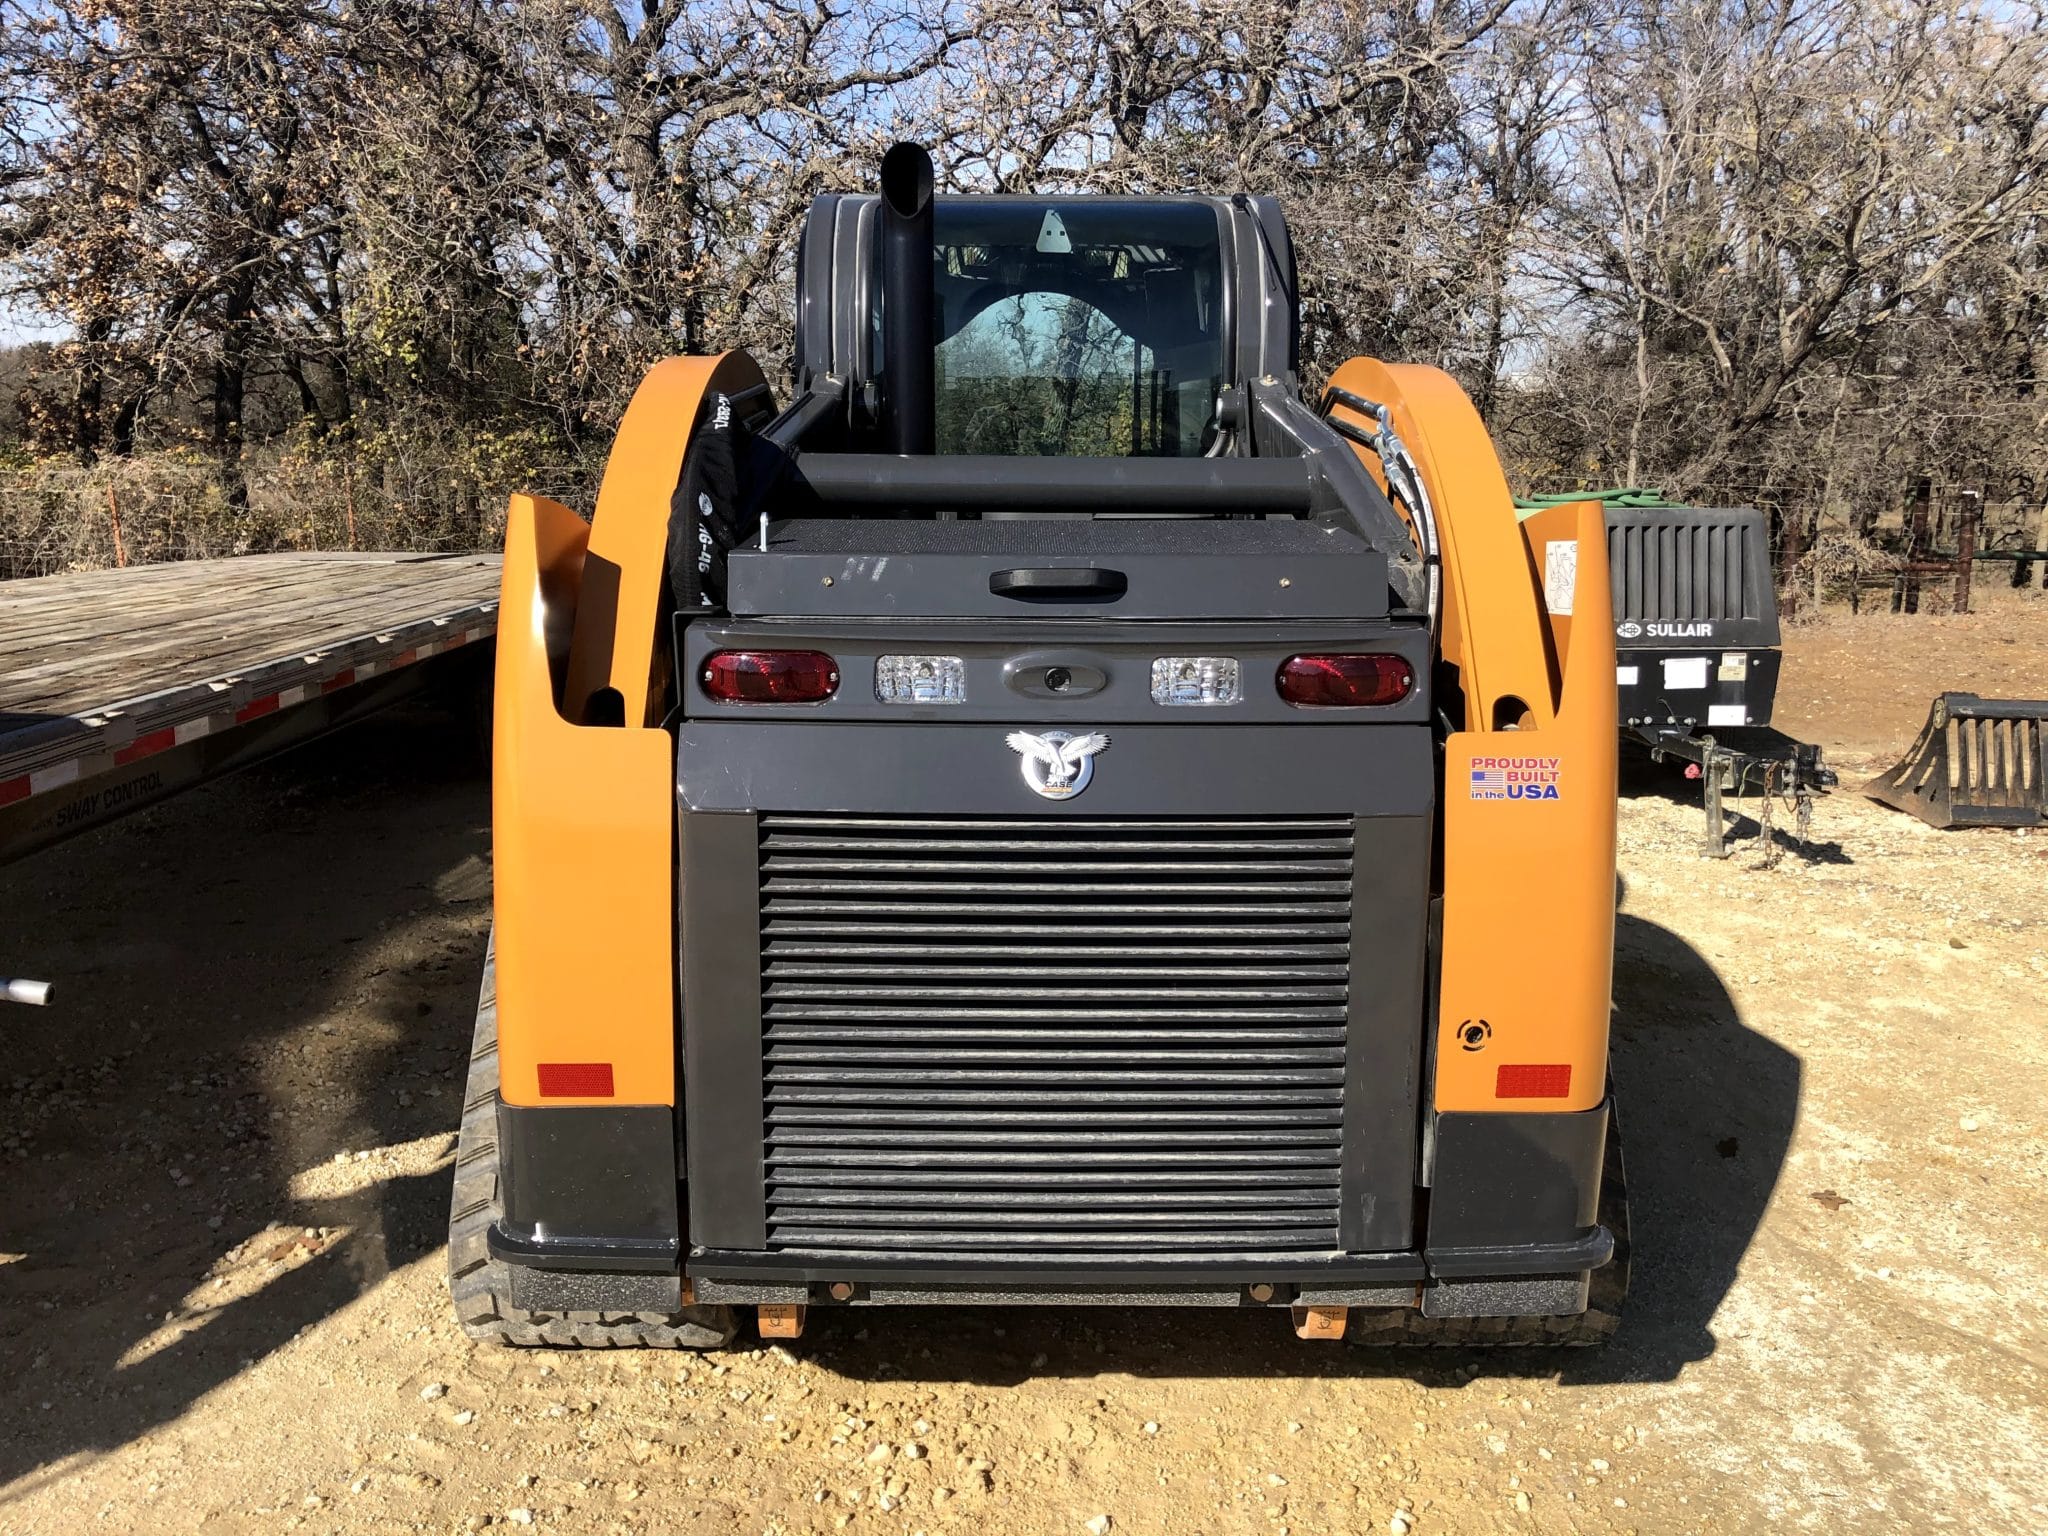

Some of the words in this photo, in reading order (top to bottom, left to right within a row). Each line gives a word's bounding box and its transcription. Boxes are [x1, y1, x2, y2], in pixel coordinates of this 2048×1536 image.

[1646, 623, 1713, 637] SULLAIR
[1471, 758, 1559, 769] PROUDLY
[1507, 771, 1559, 782] BUILT
[56, 795, 100, 827] SWAY
[103, 770, 163, 809] CONTROL
[1471, 791, 1482, 799] in
[1485, 791, 1505, 799] the
[1507, 784, 1559, 799] USA
